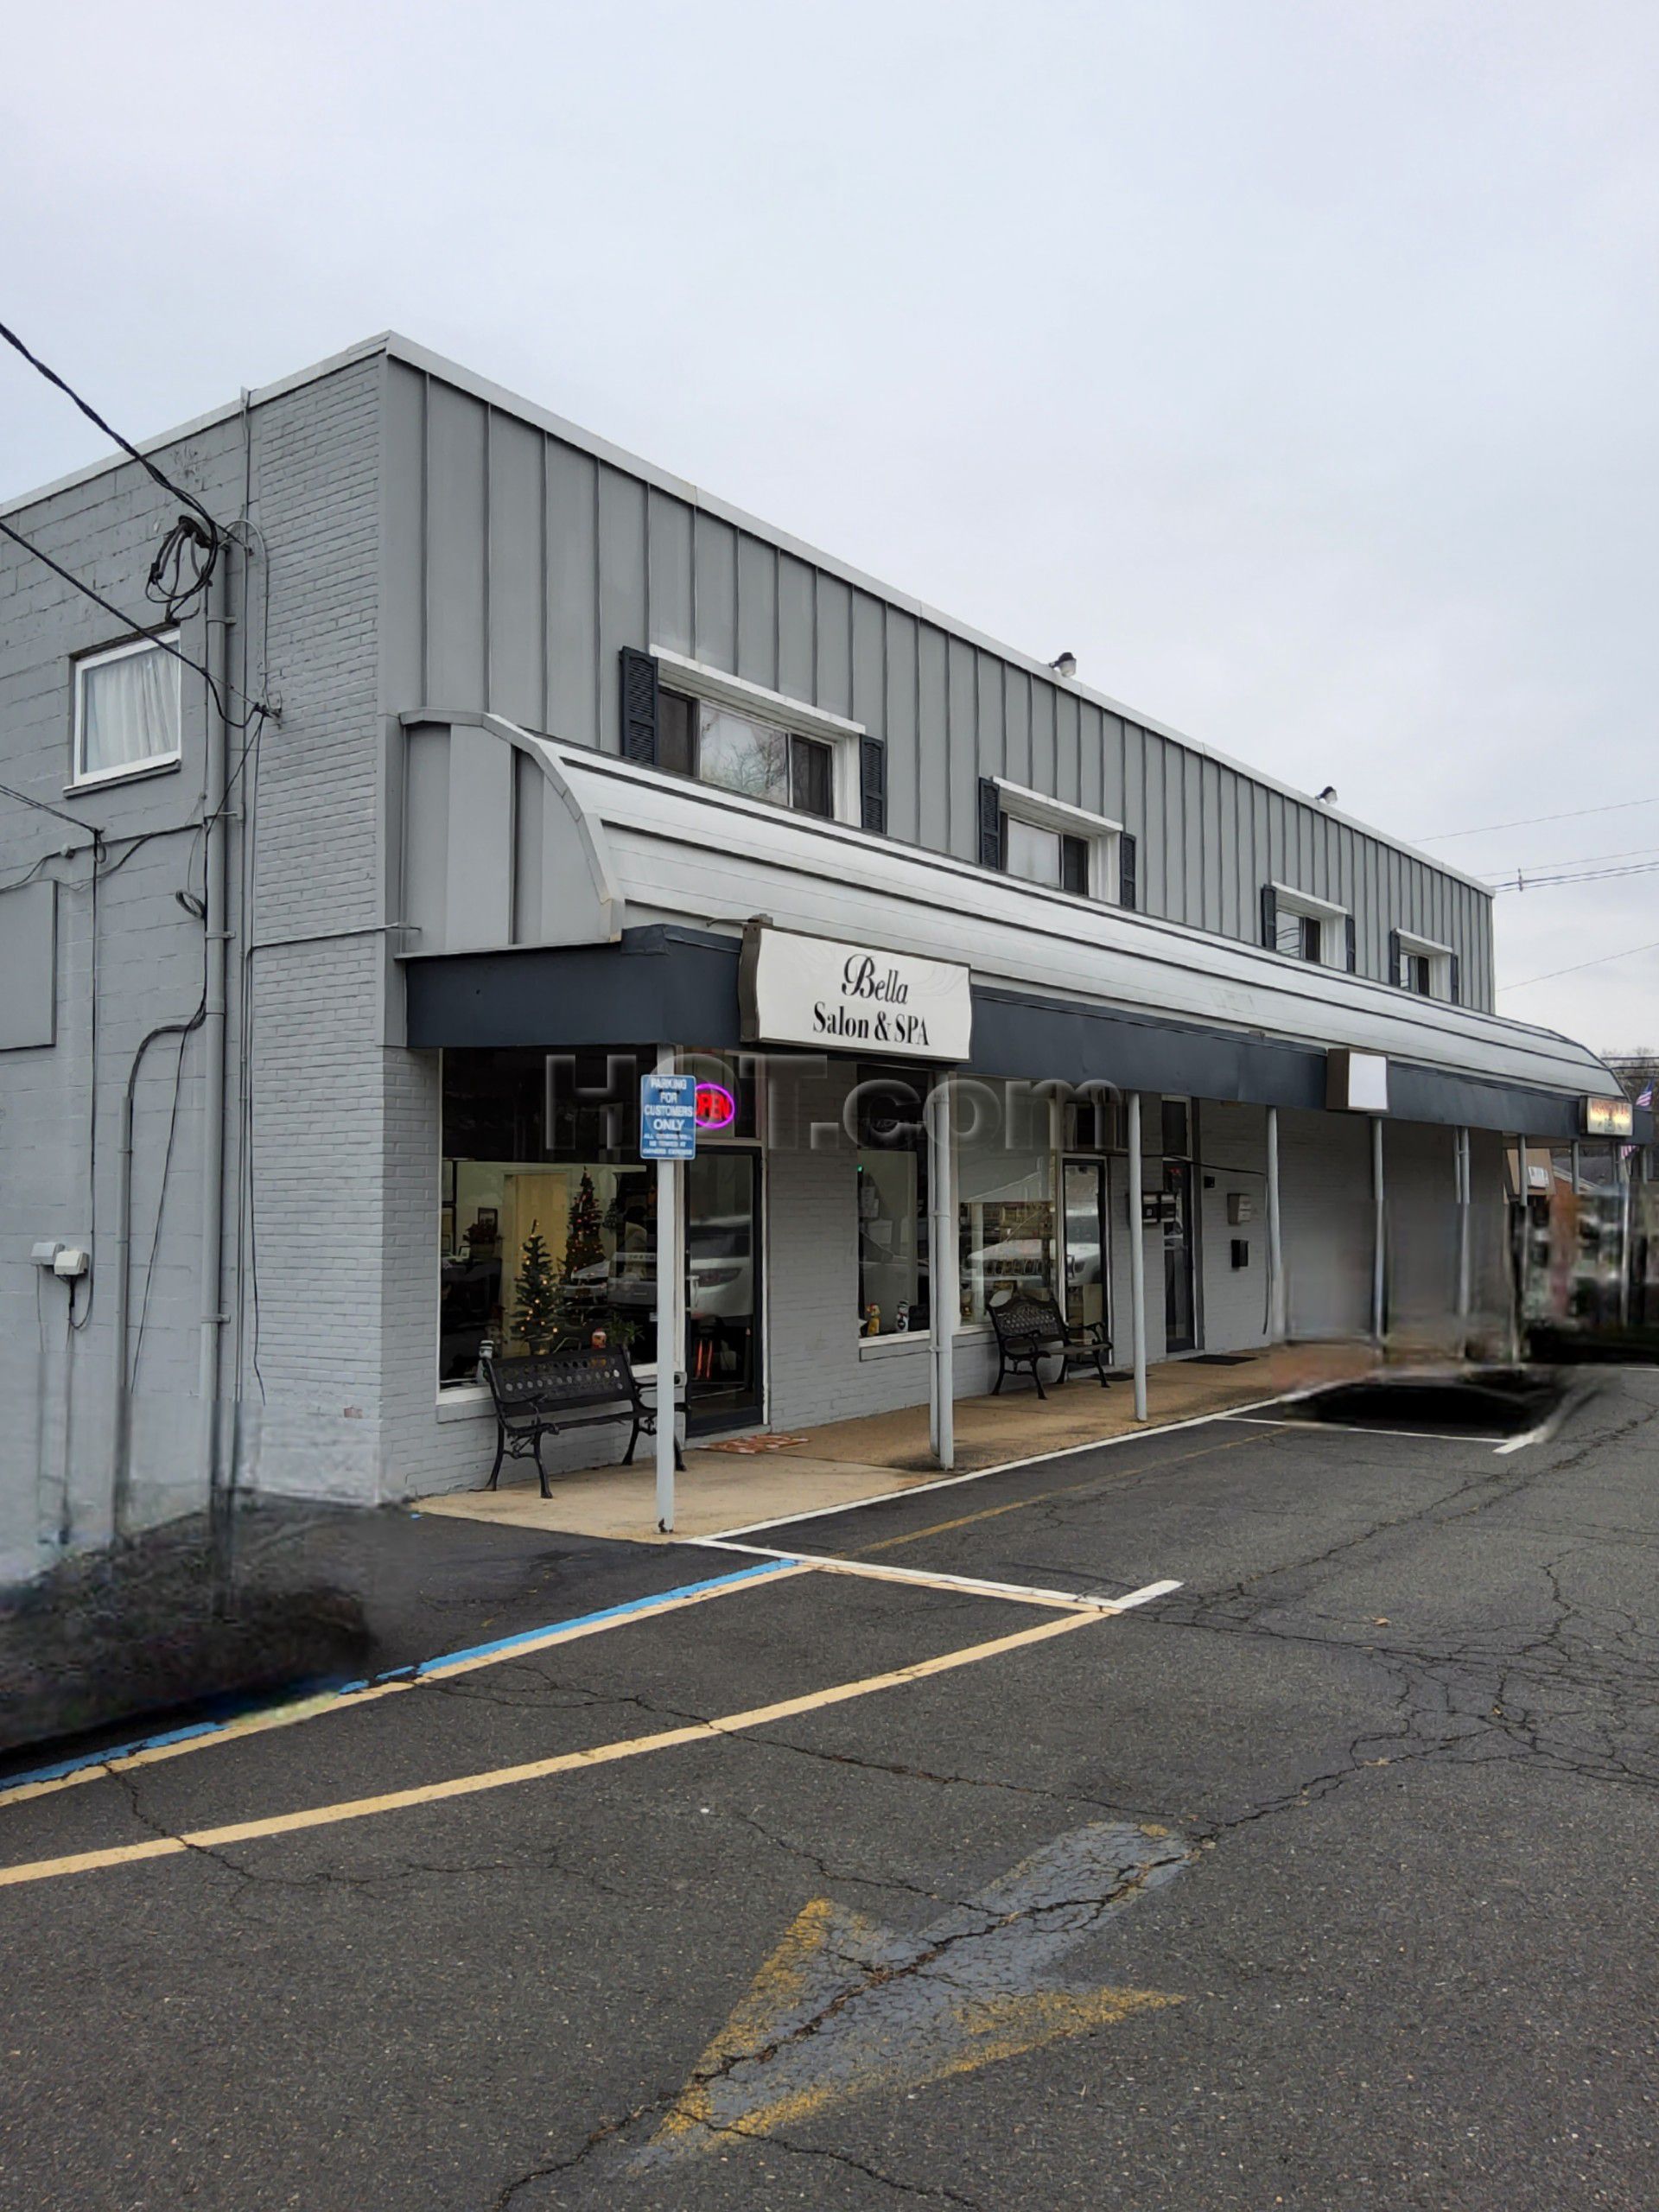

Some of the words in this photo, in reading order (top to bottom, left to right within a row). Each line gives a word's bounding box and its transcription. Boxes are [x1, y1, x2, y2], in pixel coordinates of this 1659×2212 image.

[842, 953, 909, 1004] Bella
[813, 1001, 869, 1039] Salon
[874, 1011, 892, 1040] &
[894, 1013, 930, 1046] SPA
[651, 1078, 686, 1090] PARKING
[660, 1091, 677, 1103] FOR
[644, 1105, 693, 1116] CUSTOMERS
[653, 1119, 685, 1131] ONLY
